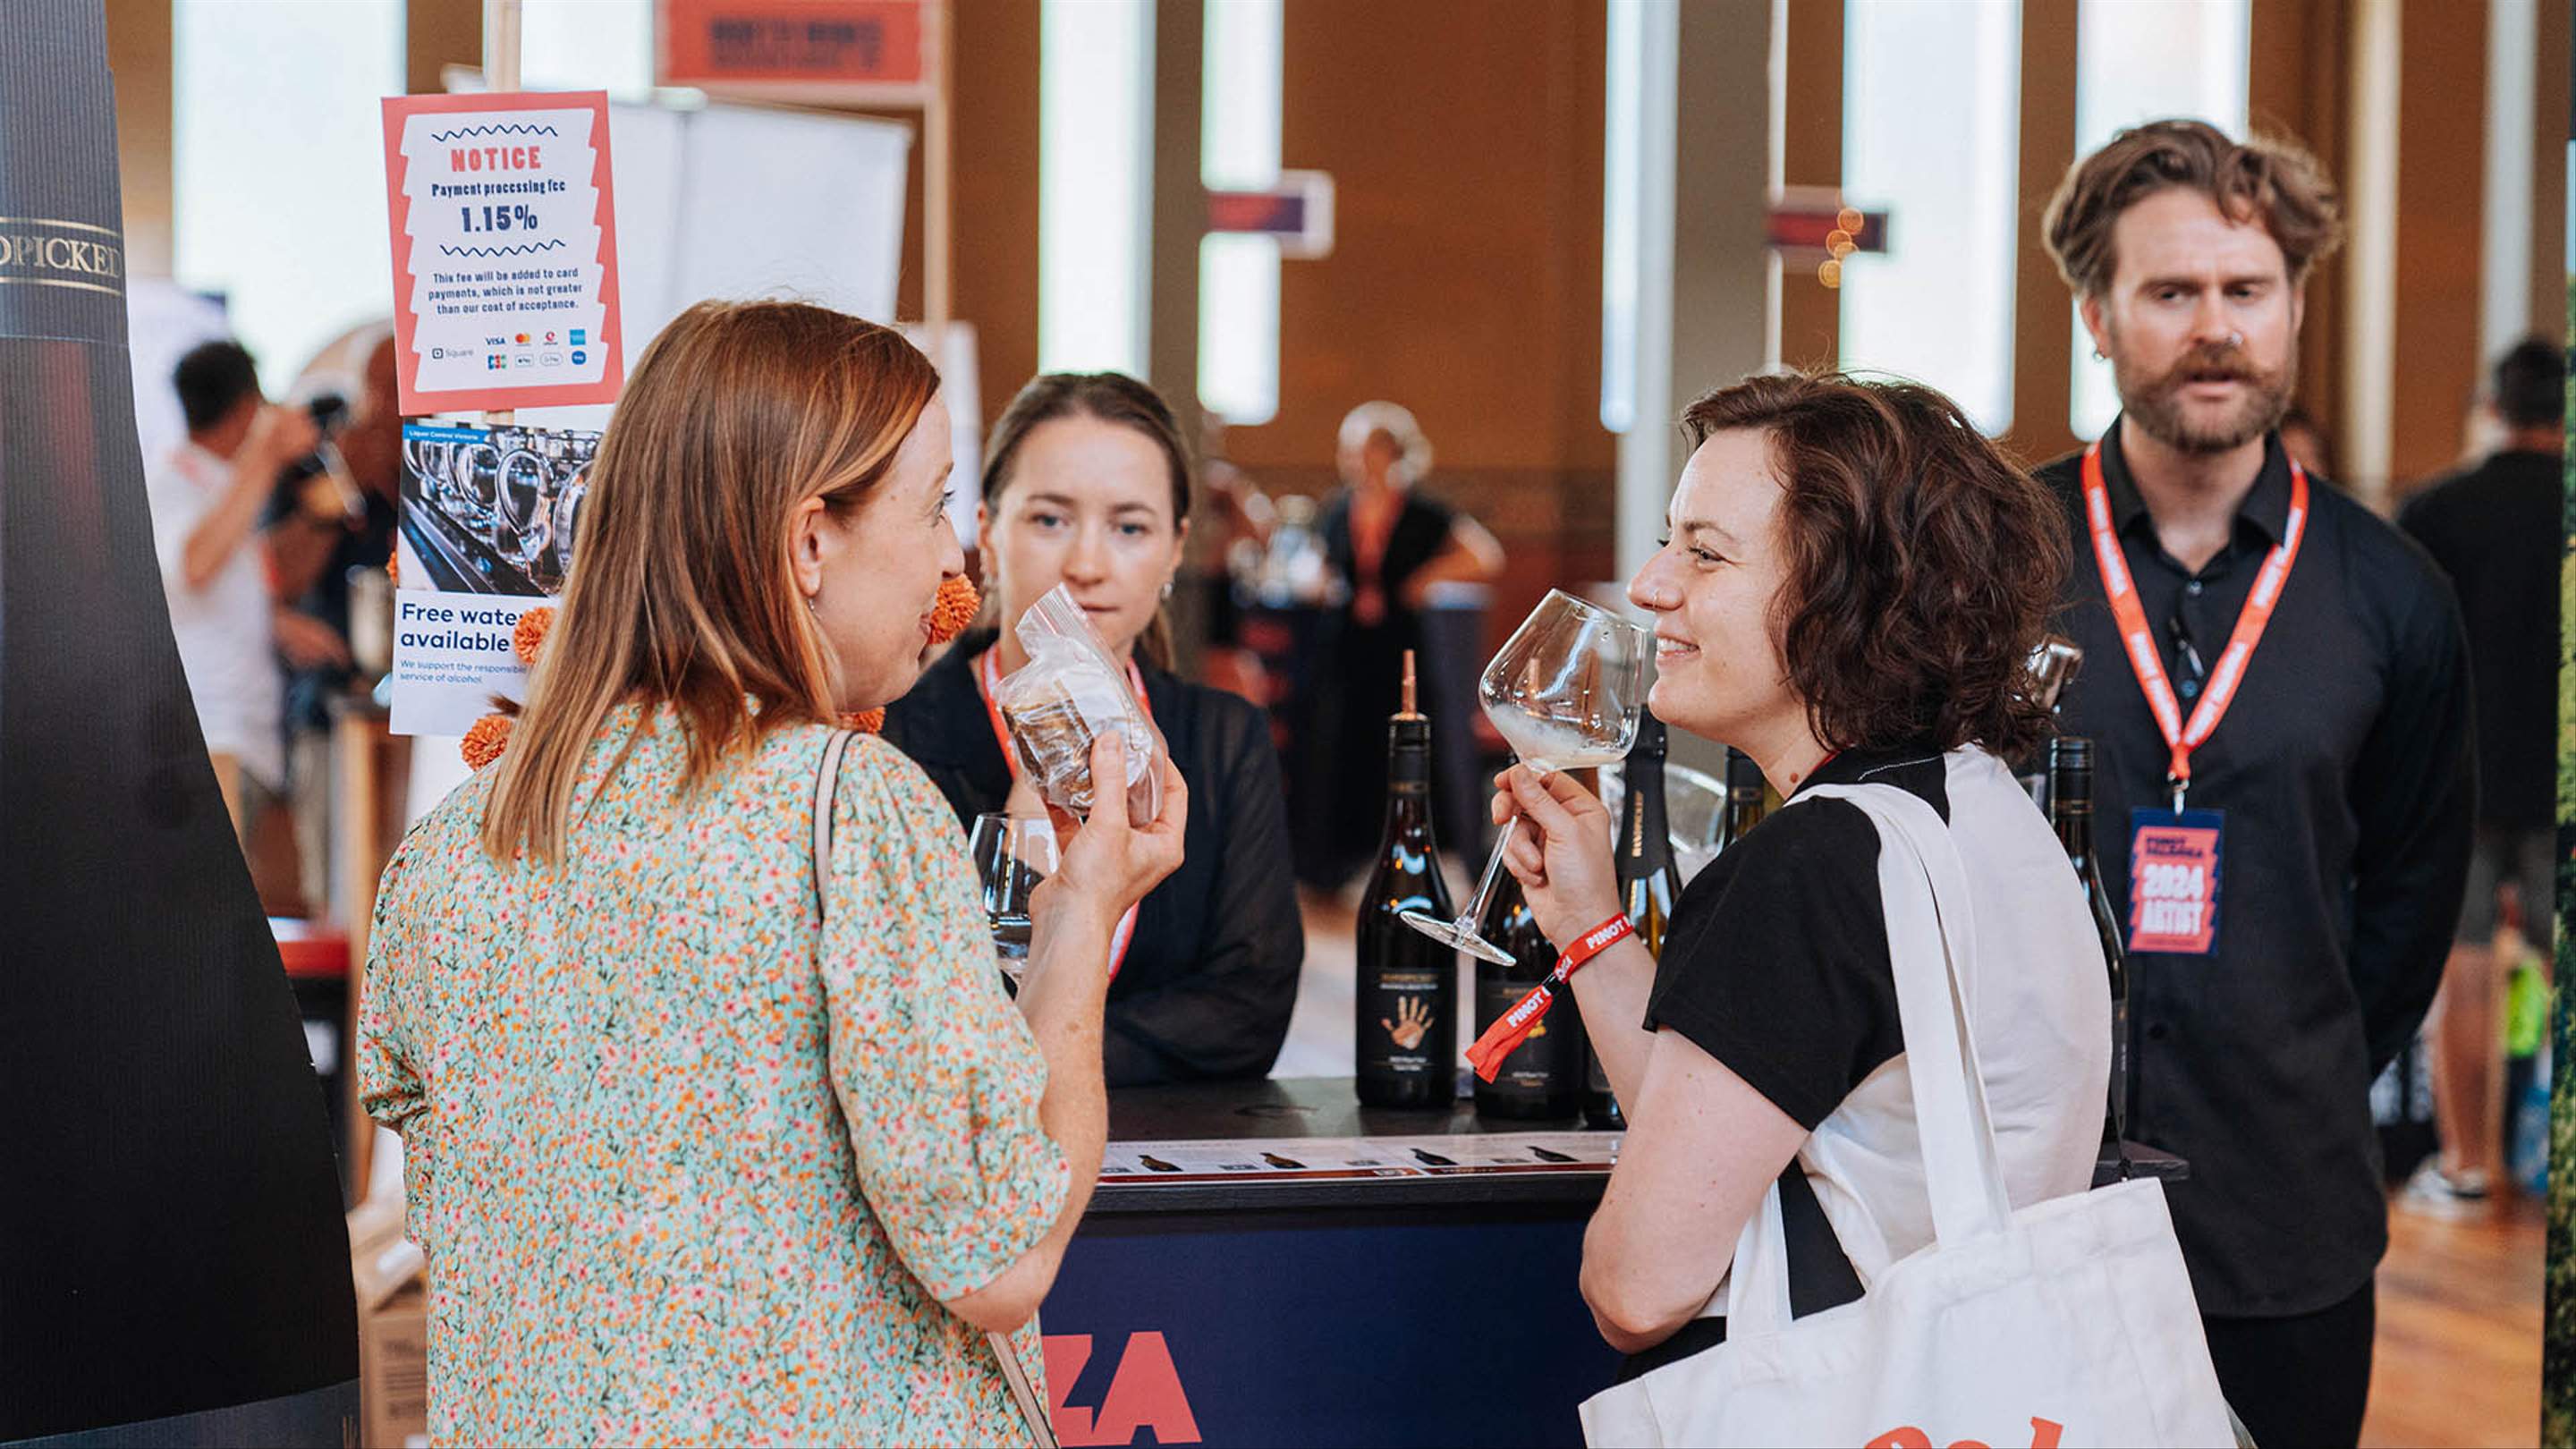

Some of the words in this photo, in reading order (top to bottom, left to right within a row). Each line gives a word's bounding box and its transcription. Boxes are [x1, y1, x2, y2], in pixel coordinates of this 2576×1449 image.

[450, 145, 542, 173] NOTICE
[431, 182, 481, 199] Payment
[484, 179, 545, 196] processing
[547, 178, 566, 191] fee
[461, 204, 538, 233] 1.15%
[433, 273, 454, 284] This
[456, 272, 472, 283] fee
[474, 271, 494, 282] will
[496, 270, 508, 281] be
[511, 269, 540, 280] added
[543, 268, 554, 278] to
[555, 267, 579, 278] card
[428, 288, 480, 301] payments,
[482, 285, 513, 297] which
[515, 284, 525, 295] is
[528, 284, 544, 294] not
[547, 283, 582, 295] greater
[436, 303, 460, 314] than
[462, 304, 479, 314] our
[481, 302, 504, 312] cost
[505, 301, 517, 311] of
[519, 299, 580, 311] acceptance.
[485, 336, 506, 345] VISA
[402, 602, 454, 623] Free
[460, 608, 523, 627] wate
[400, 630, 511, 652] available
[400, 660, 416, 668] We
[417, 661, 455, 671] support
[457, 662, 473, 672] the
[400, 673, 435, 682] service
[436, 674, 446, 682] of
[2141, 862, 2205, 901] 2024
[1586, 920, 1625, 950] PINOT
[1506, 991, 1545, 1028] PINOT
